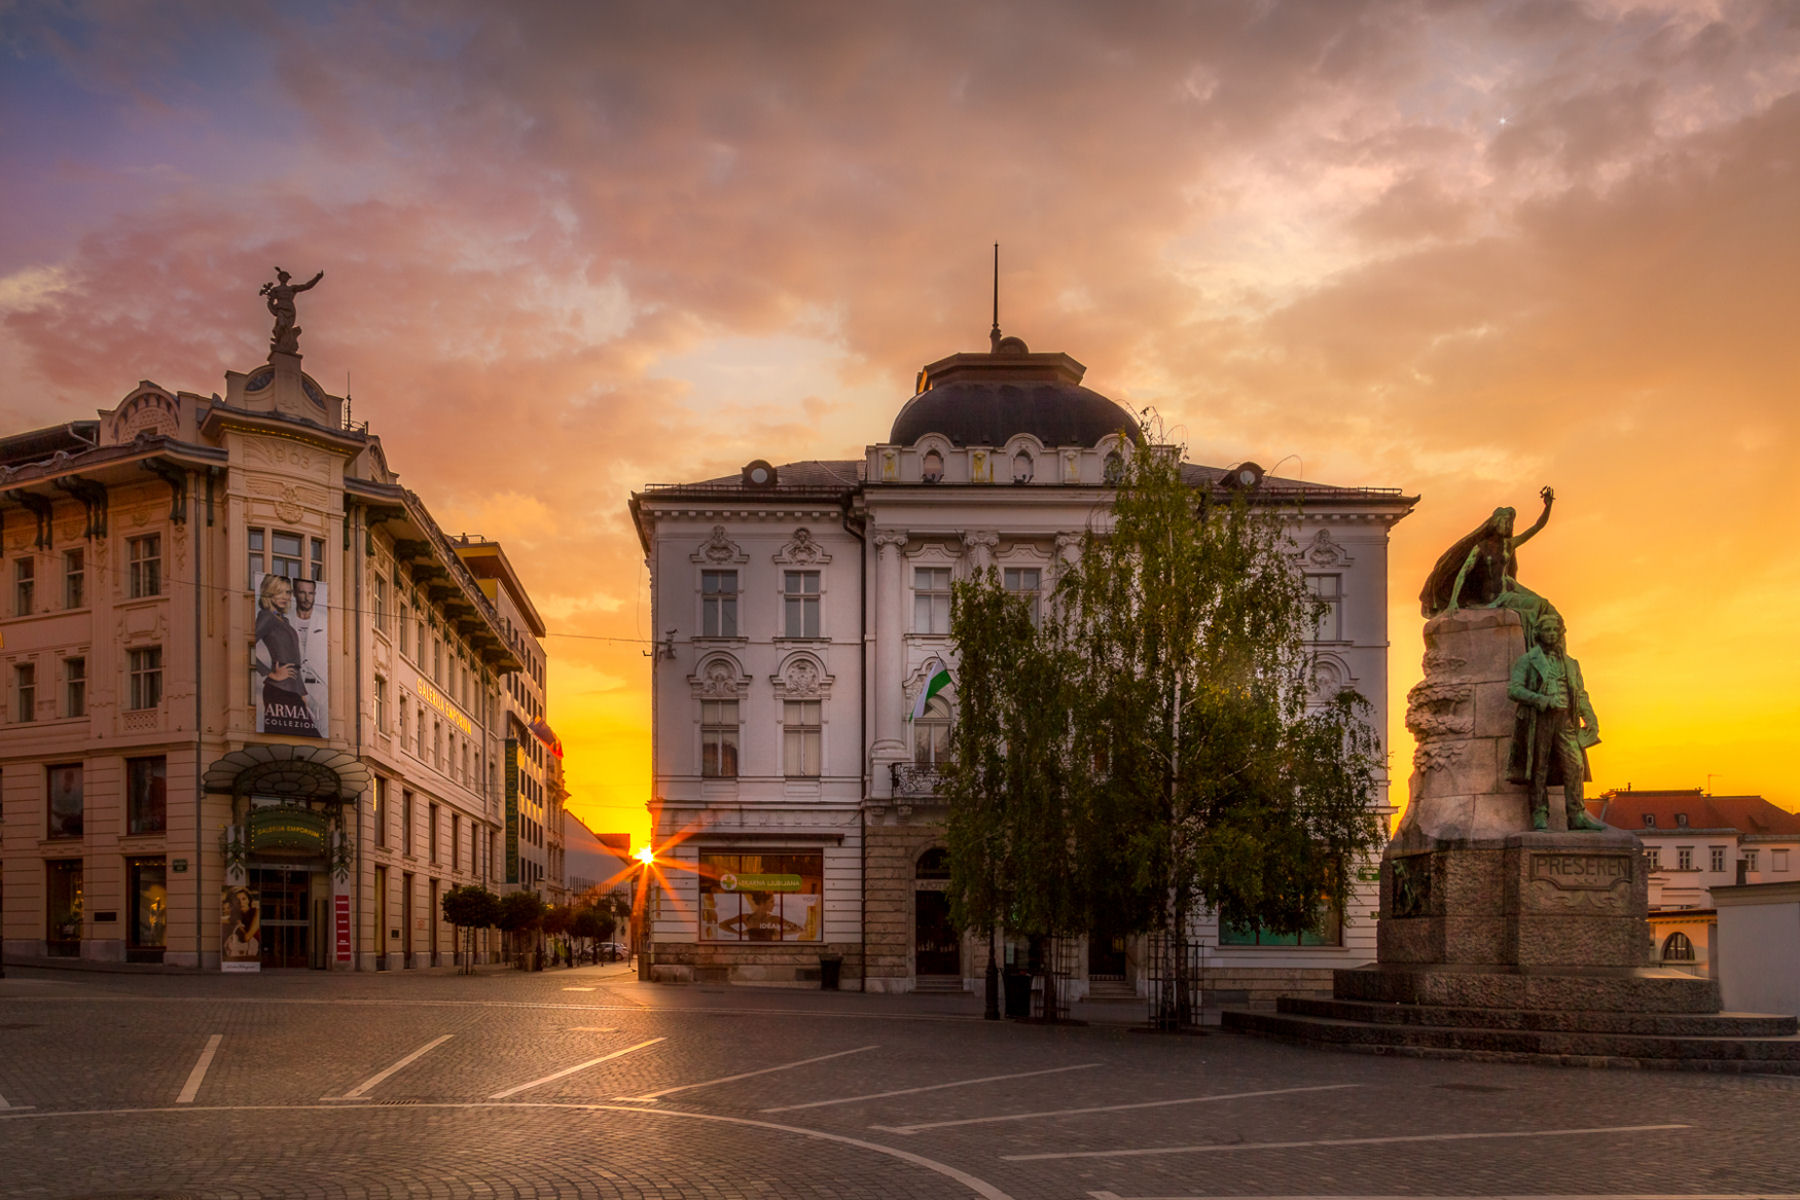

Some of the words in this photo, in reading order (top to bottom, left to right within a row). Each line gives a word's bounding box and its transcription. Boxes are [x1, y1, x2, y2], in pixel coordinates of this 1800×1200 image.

[265, 703, 320, 720] ARMANI
[416, 677, 444, 712] GALERIJA
[445, 701, 471, 736] EMPORIUM
[286, 826, 319, 838] EMPORIUM
